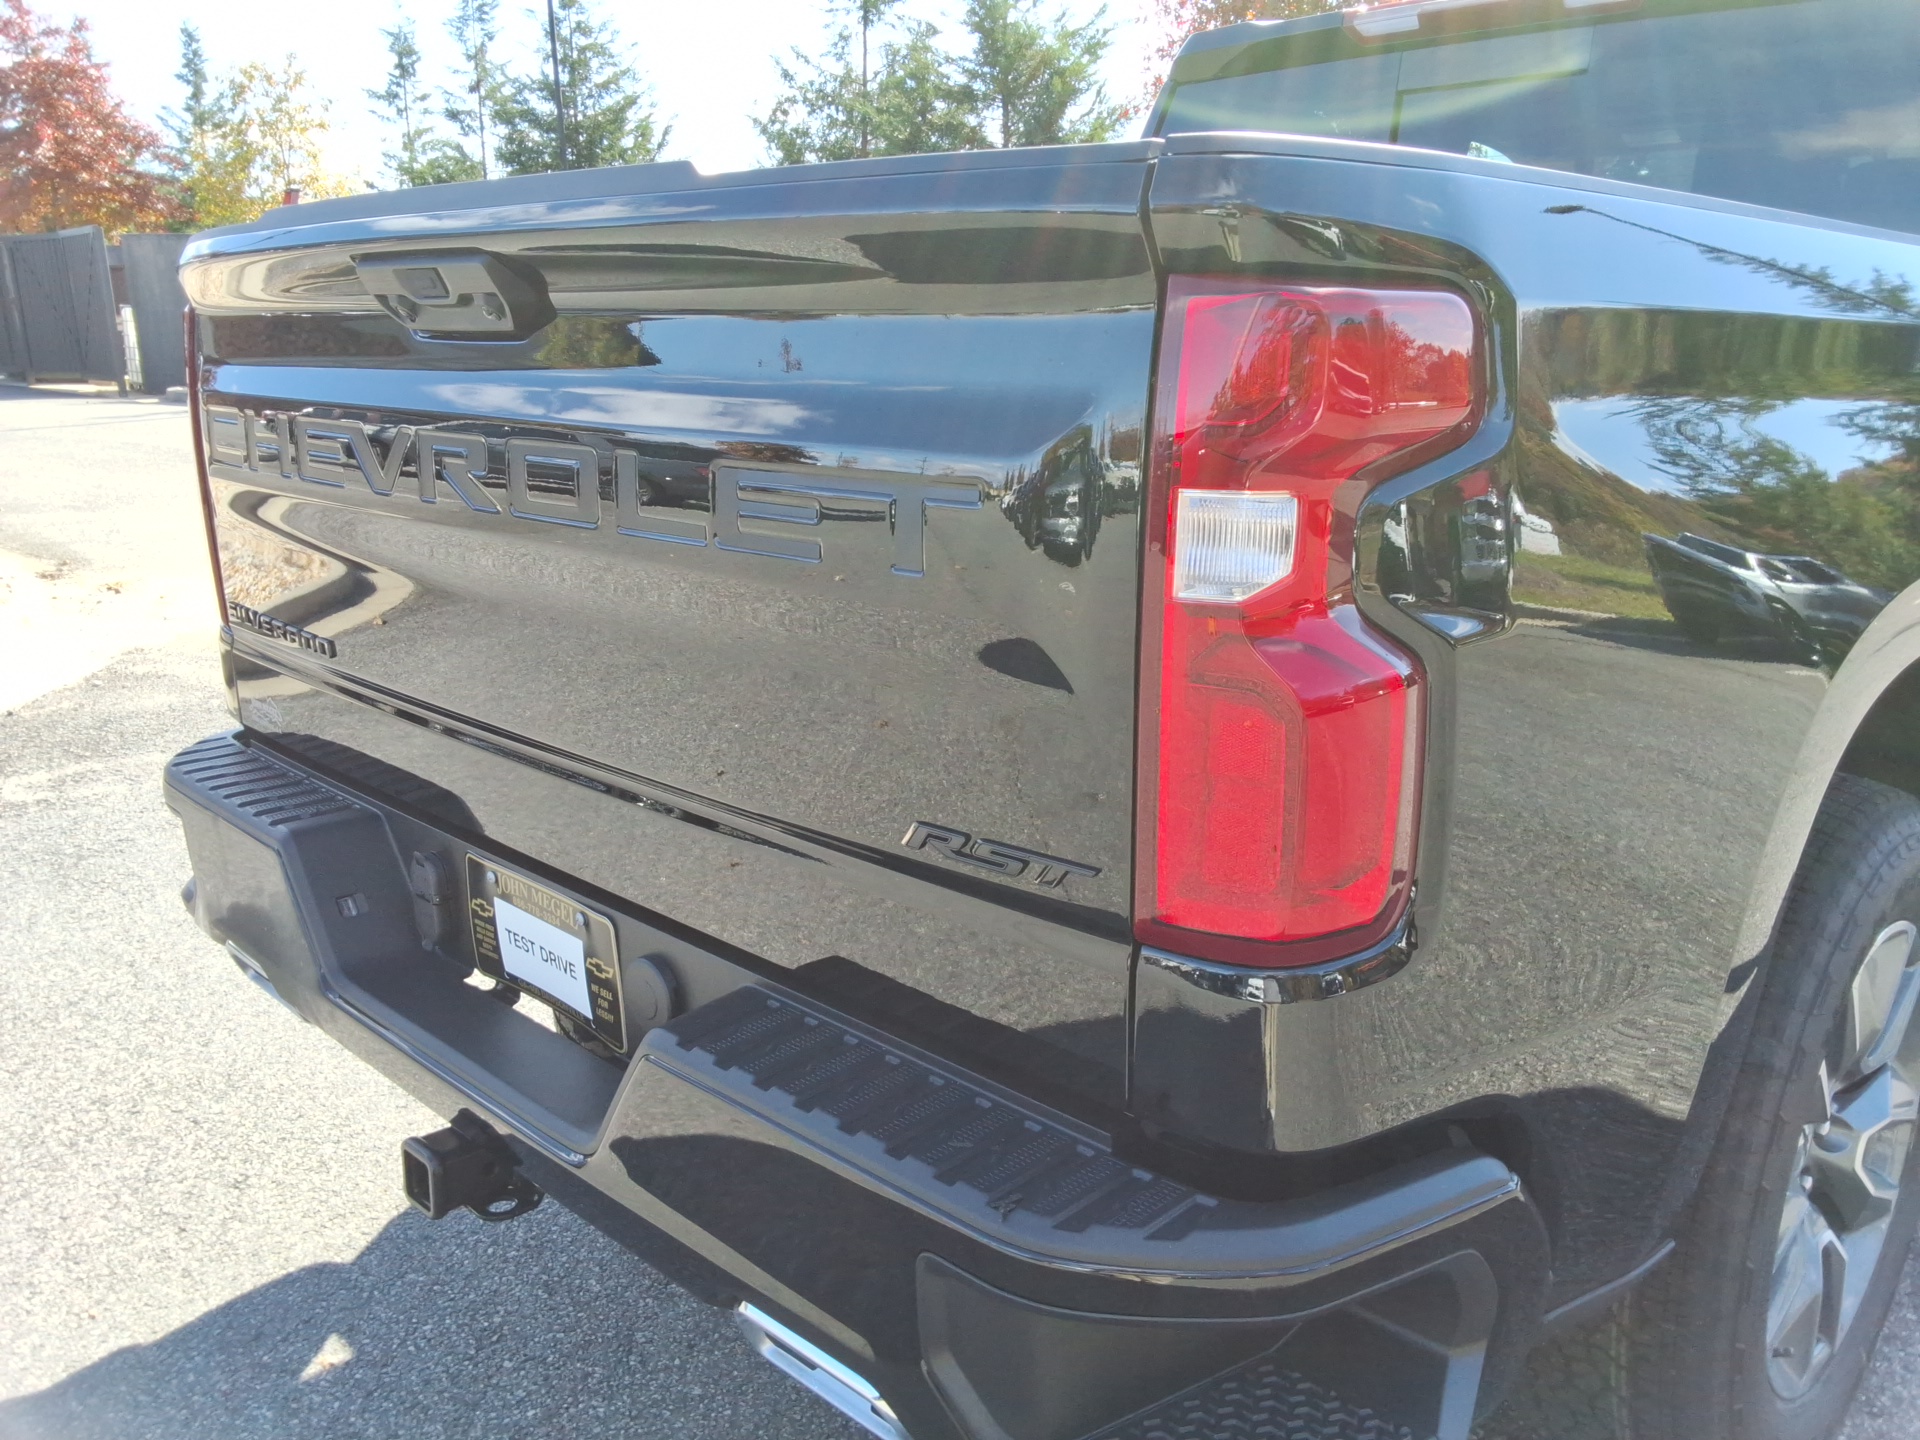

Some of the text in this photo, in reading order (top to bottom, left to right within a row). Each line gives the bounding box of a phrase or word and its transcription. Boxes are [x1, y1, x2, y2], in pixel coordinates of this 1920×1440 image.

[206, 404, 985, 578] CHEVROLET
[228, 601, 338, 659] SILVERADO
[901, 820, 1103, 888] RST
[497, 874, 580, 931] JOHN MEGEL
[505, 928, 536, 956] TEST
[539, 945, 578, 981] DRIVE
[598, 997, 609, 1009] FOR
[600, 987, 613, 1001] SELL
